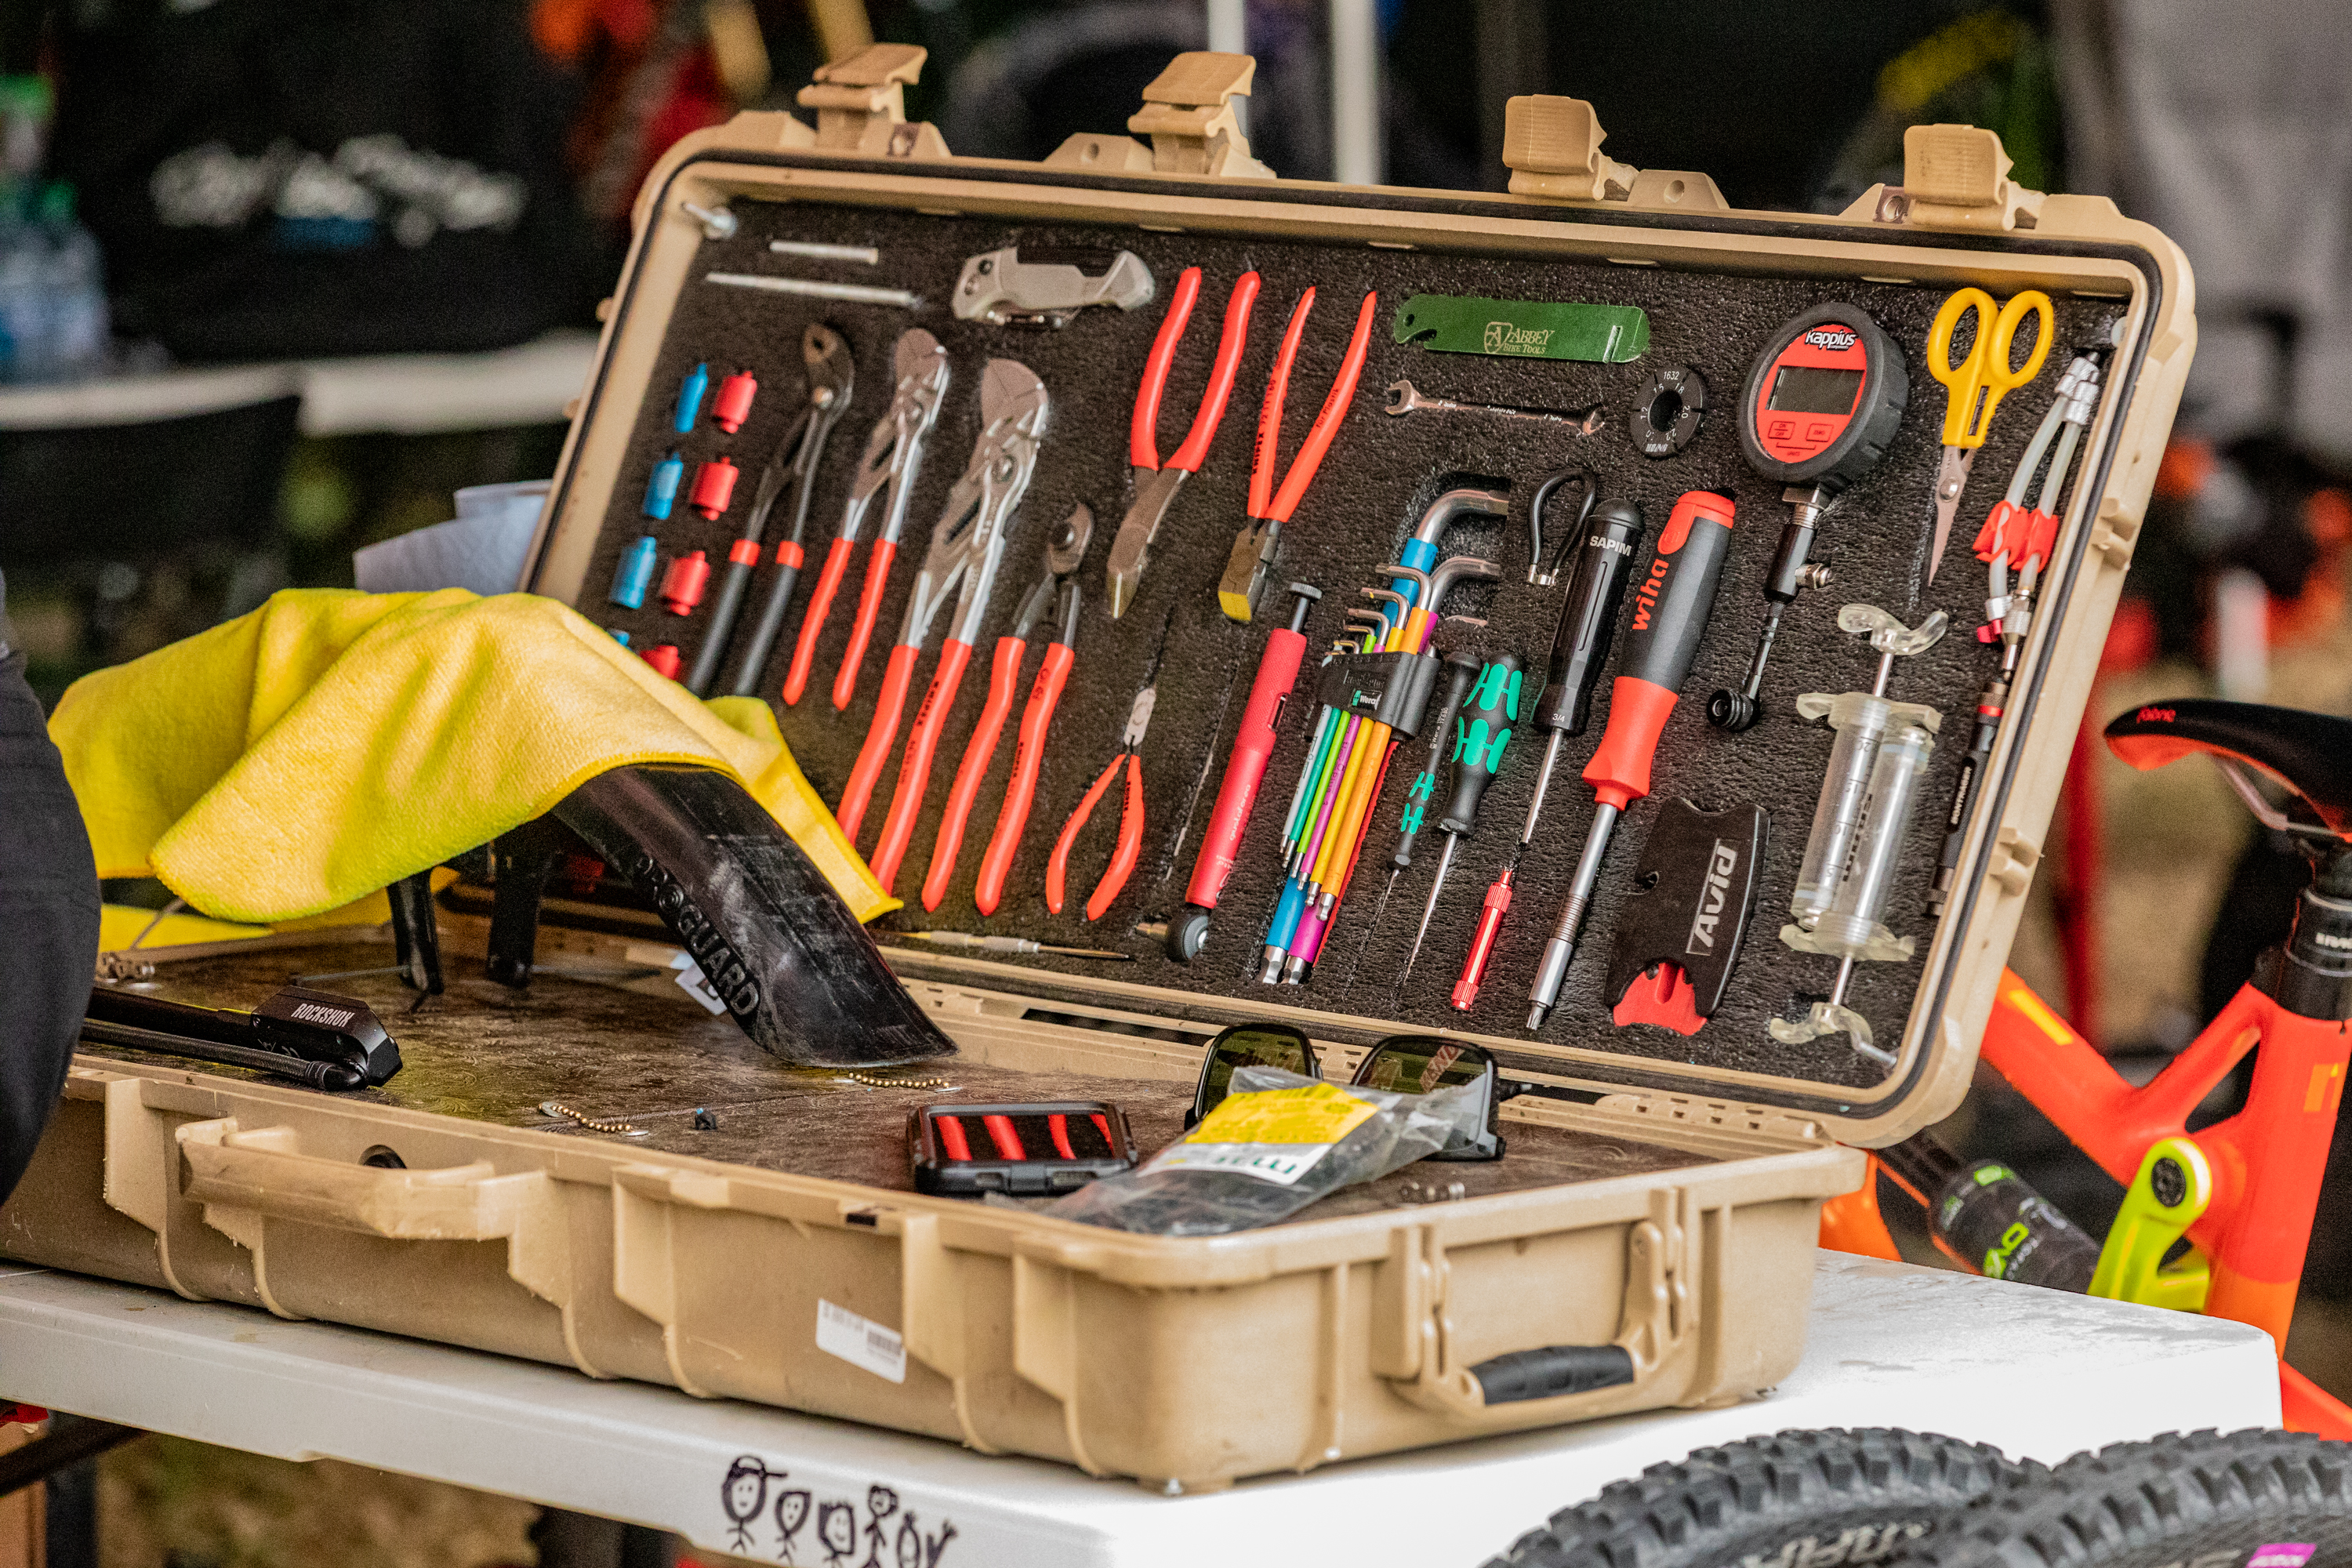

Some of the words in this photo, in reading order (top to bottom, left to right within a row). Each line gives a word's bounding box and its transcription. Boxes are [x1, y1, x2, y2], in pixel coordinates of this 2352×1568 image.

[1508, 328, 1555, 345] ABBEY
[1806, 330, 1857, 349] kappius
[1503, 343, 1521, 353] BIKE
[1523, 343, 1546, 354] TOOLS
[1664, 371, 1679, 380] 1632
[1589, 535, 1632, 557] SAPIM
[1632, 558, 1670, 630] wiha
[1359, 695, 1377, 705] Wera
[1552, 713, 1566, 723] 3/4
[1951, 766, 1972, 824] BONTRAGER
[1695, 845, 1737, 947] Avid
[291, 1003, 355, 1028] ROCKSHOX
